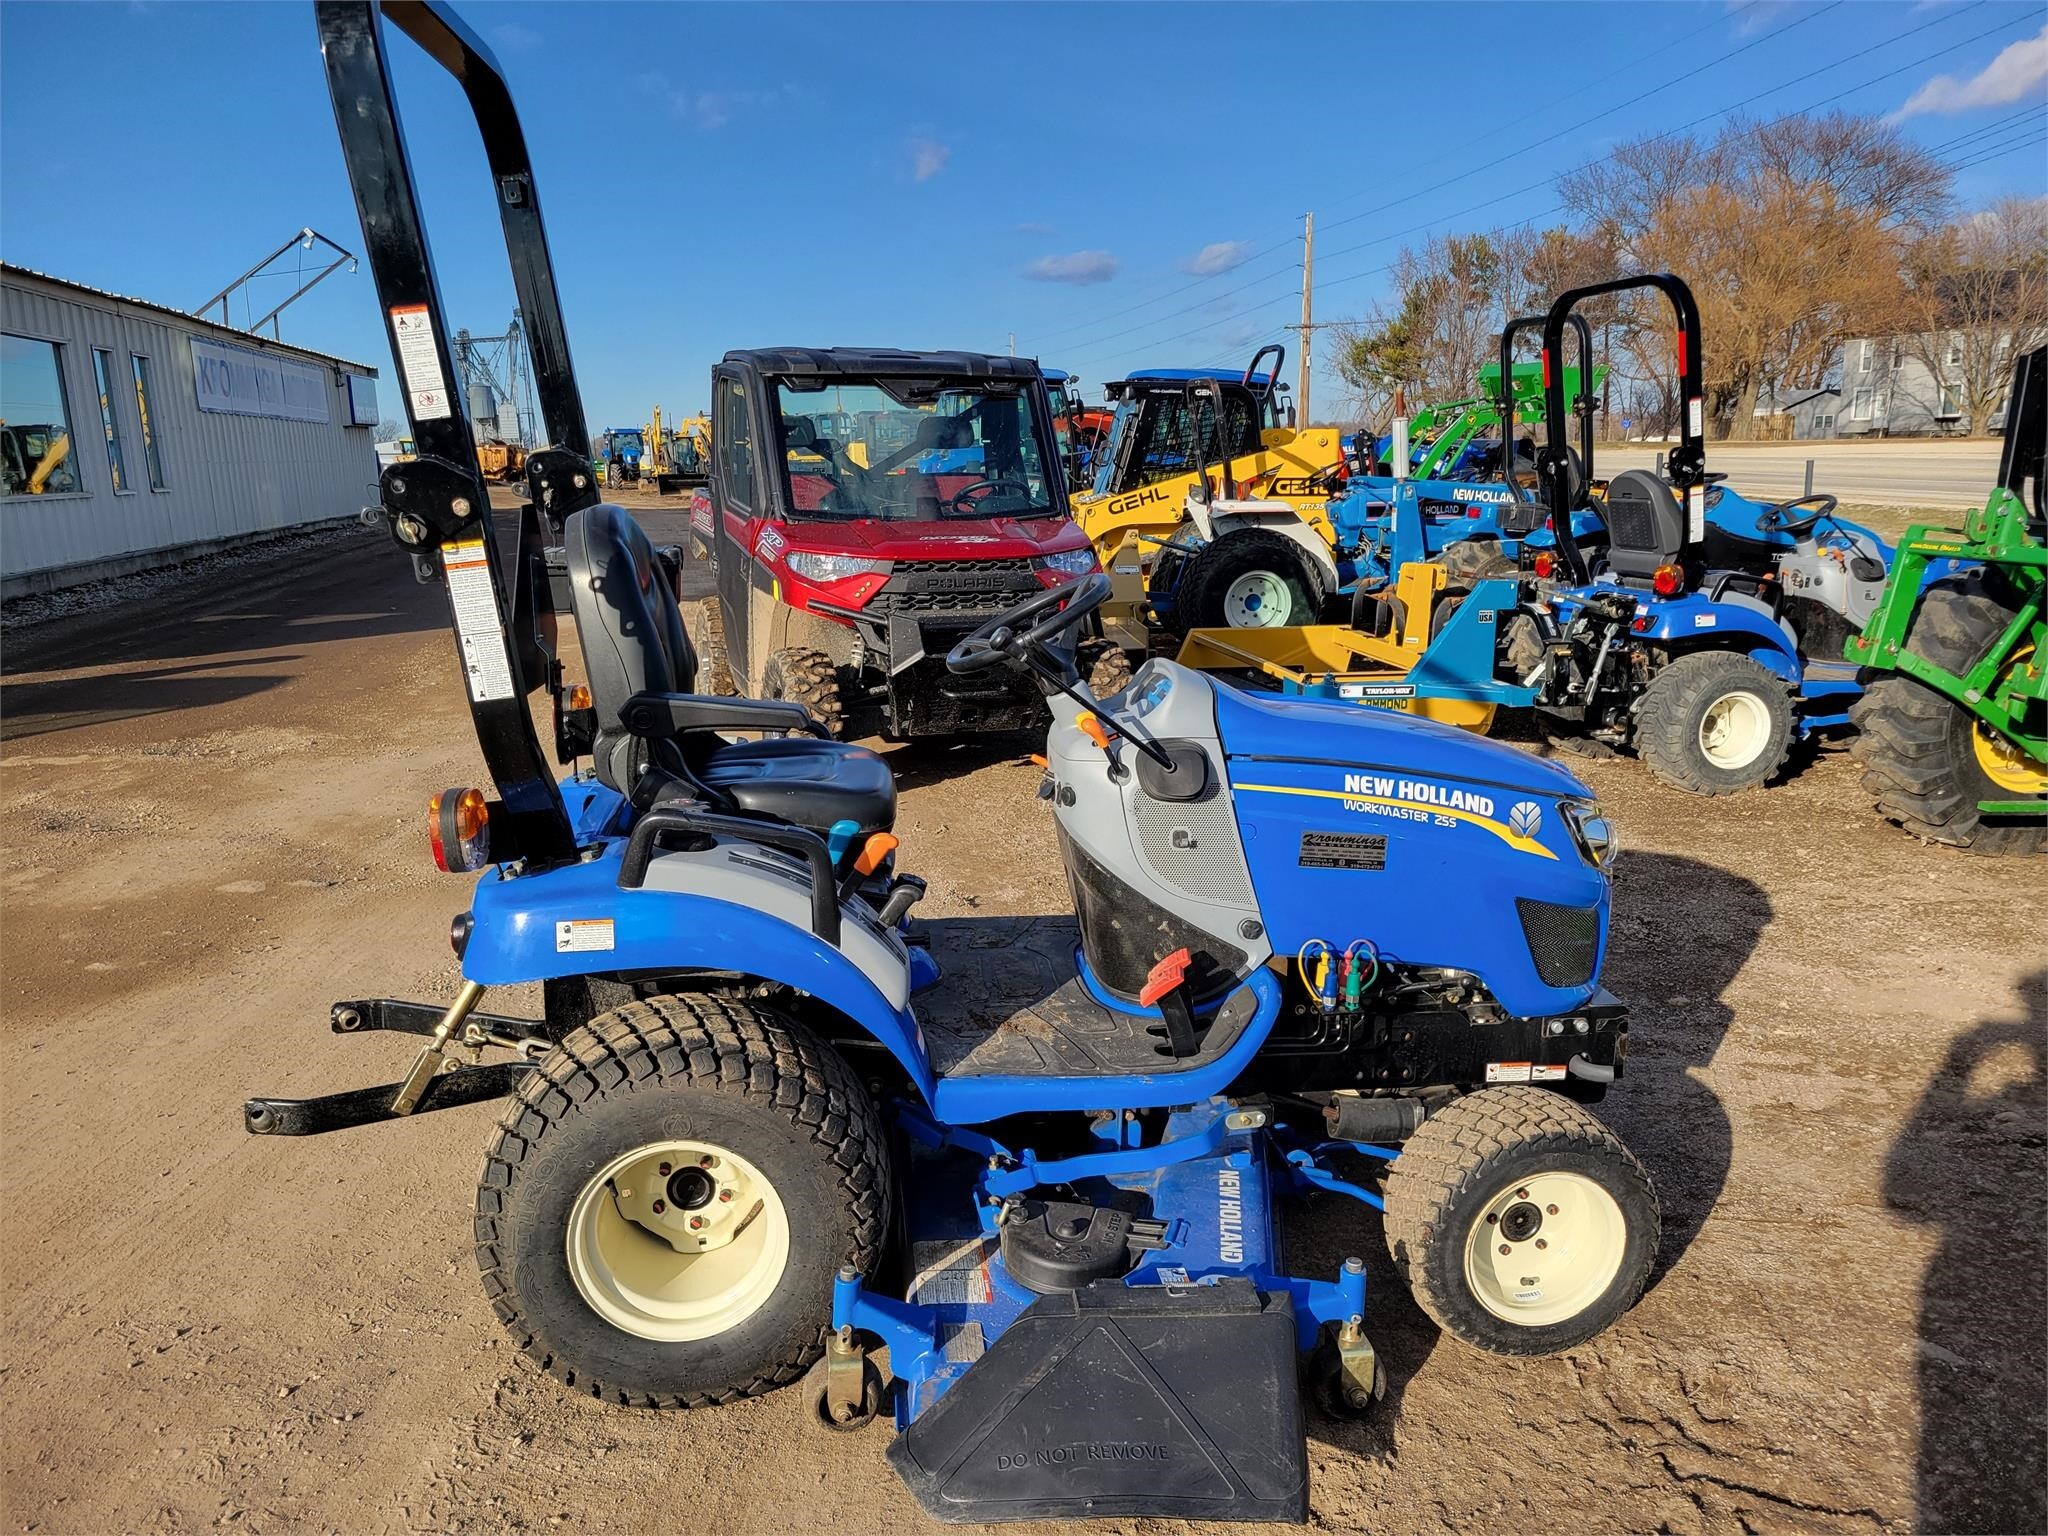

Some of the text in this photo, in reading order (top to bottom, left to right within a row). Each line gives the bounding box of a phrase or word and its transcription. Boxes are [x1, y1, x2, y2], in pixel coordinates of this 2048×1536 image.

[1108, 488, 1169, 515] GEHL
[1453, 489, 1516, 503] NEW HOLLAN
[1299, 503, 1324, 511] RT135
[1425, 505, 1459, 515] HOLLAND
[761, 527, 784, 547] XP
[927, 578, 1005, 590] POLARIS
[1479, 614, 1493, 622] USA
[1366, 687, 1412, 695] TAYLOR-WAY
[1344, 774, 1494, 817] NEW HOLLAND
[1344, 799, 1457, 828] WORKMASTER 25S
[1302, 834, 1386, 849] Kromminga
[1107, 1212, 1122, 1232] STEP
[1219, 1170, 1244, 1263] NEW HOLLAND
[997, 1445, 1170, 1471] DO NOT REMOVE
